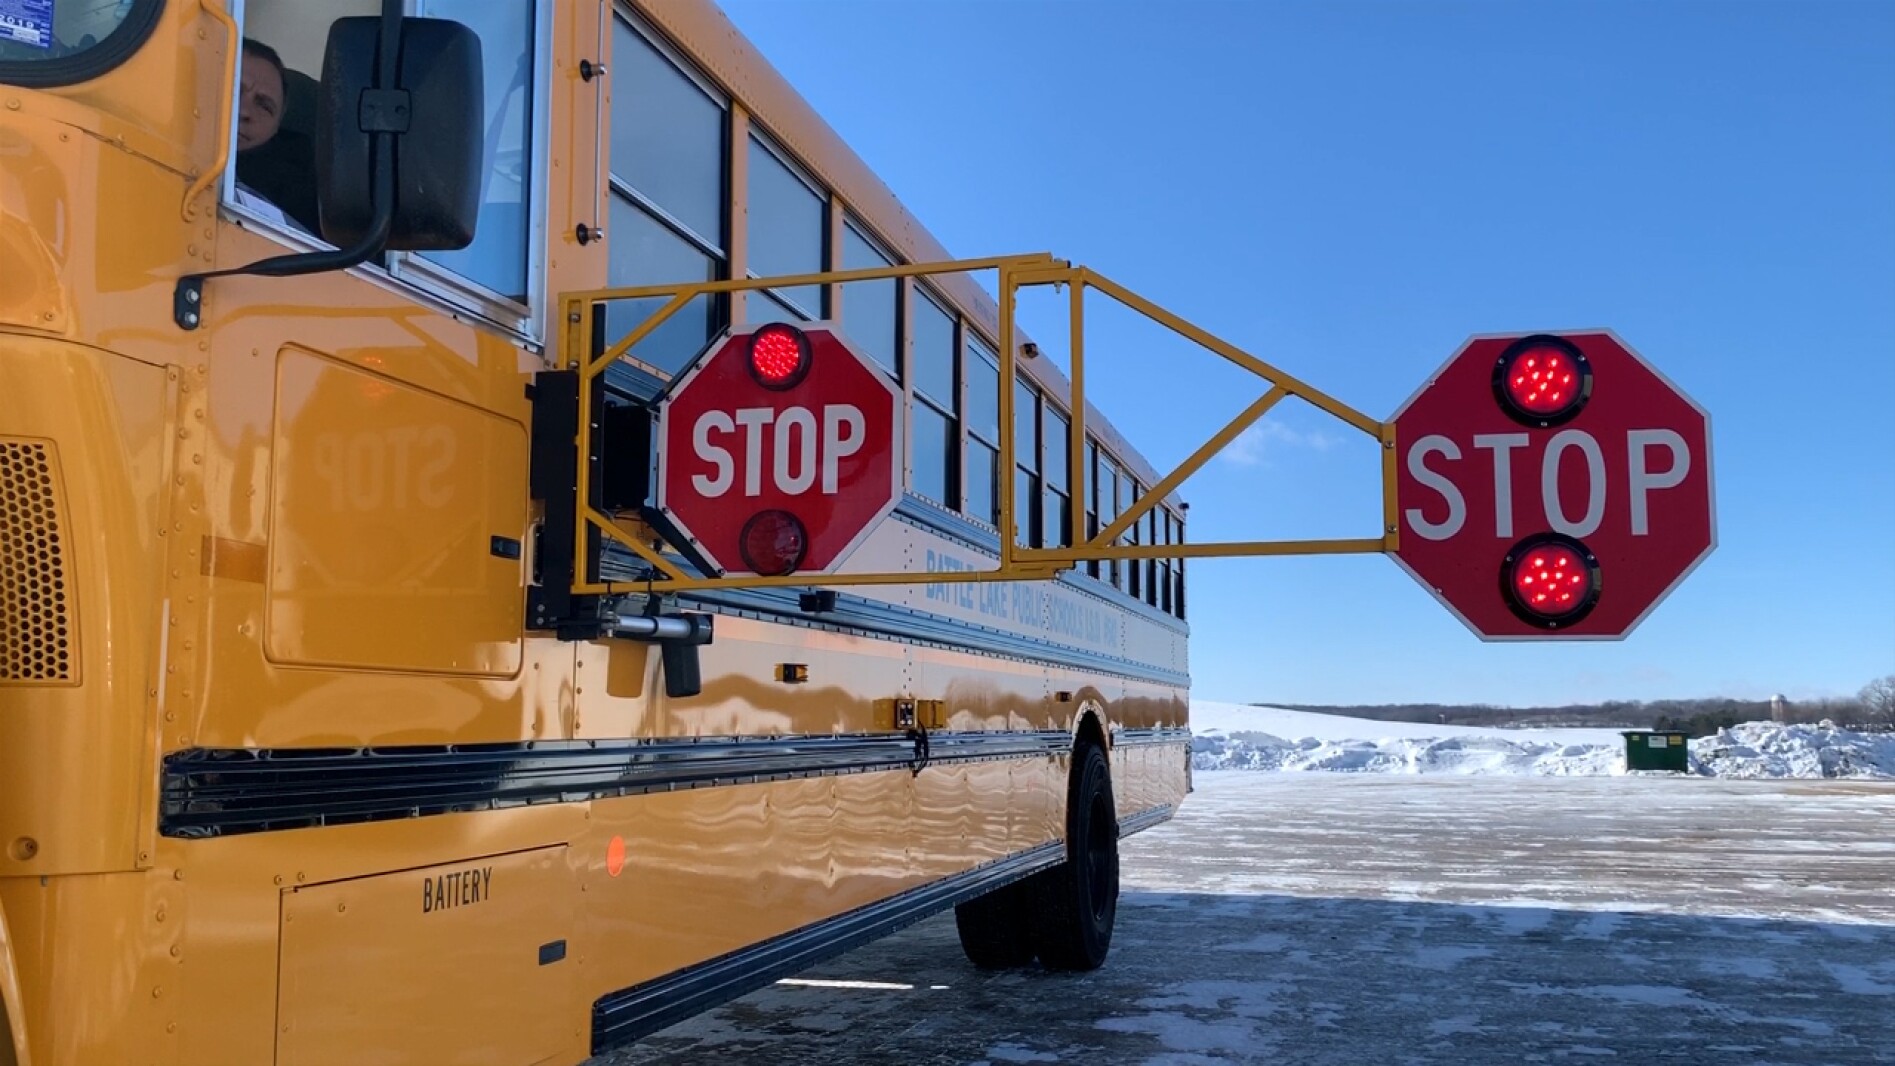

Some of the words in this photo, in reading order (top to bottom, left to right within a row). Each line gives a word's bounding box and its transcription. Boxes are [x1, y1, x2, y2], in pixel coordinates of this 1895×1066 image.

[691, 404, 866, 498] STOP
[1405, 428, 1691, 541] STOP
[926, 549, 974, 609] BATTLE
[980, 580, 1008, 618] LAKE
[1013, 582, 1046, 629] PUBLIC
[423, 866, 492, 913] BATTERY
